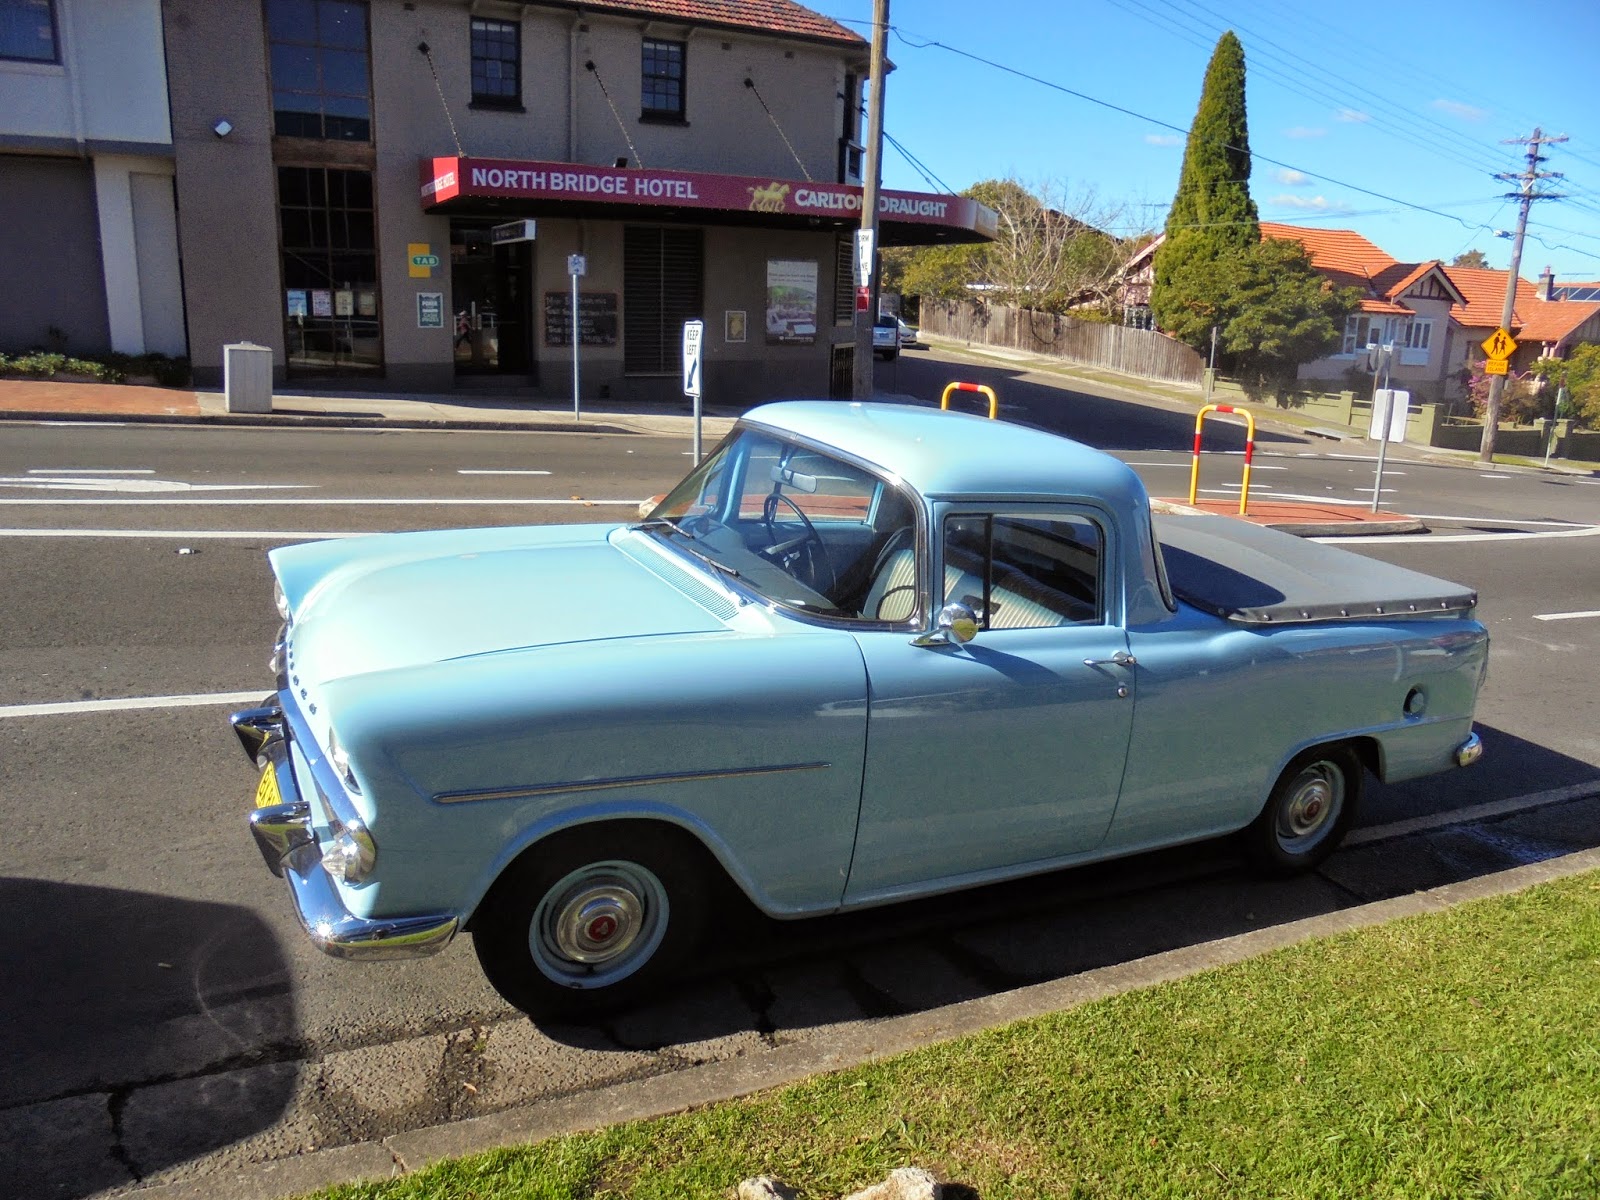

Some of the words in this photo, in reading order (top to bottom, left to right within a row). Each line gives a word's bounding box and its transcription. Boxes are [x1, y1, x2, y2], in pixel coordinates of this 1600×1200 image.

[472, 168, 546, 190] NORTH
[550, 172, 628, 195] BRIDGE
[634, 178, 699, 199] HOTEL
[879, 195, 948, 218] DRAUGHT
[415, 257, 436, 265] TAB
[687, 329, 700, 341] KEEP
[686, 344, 697, 356] LEFT
